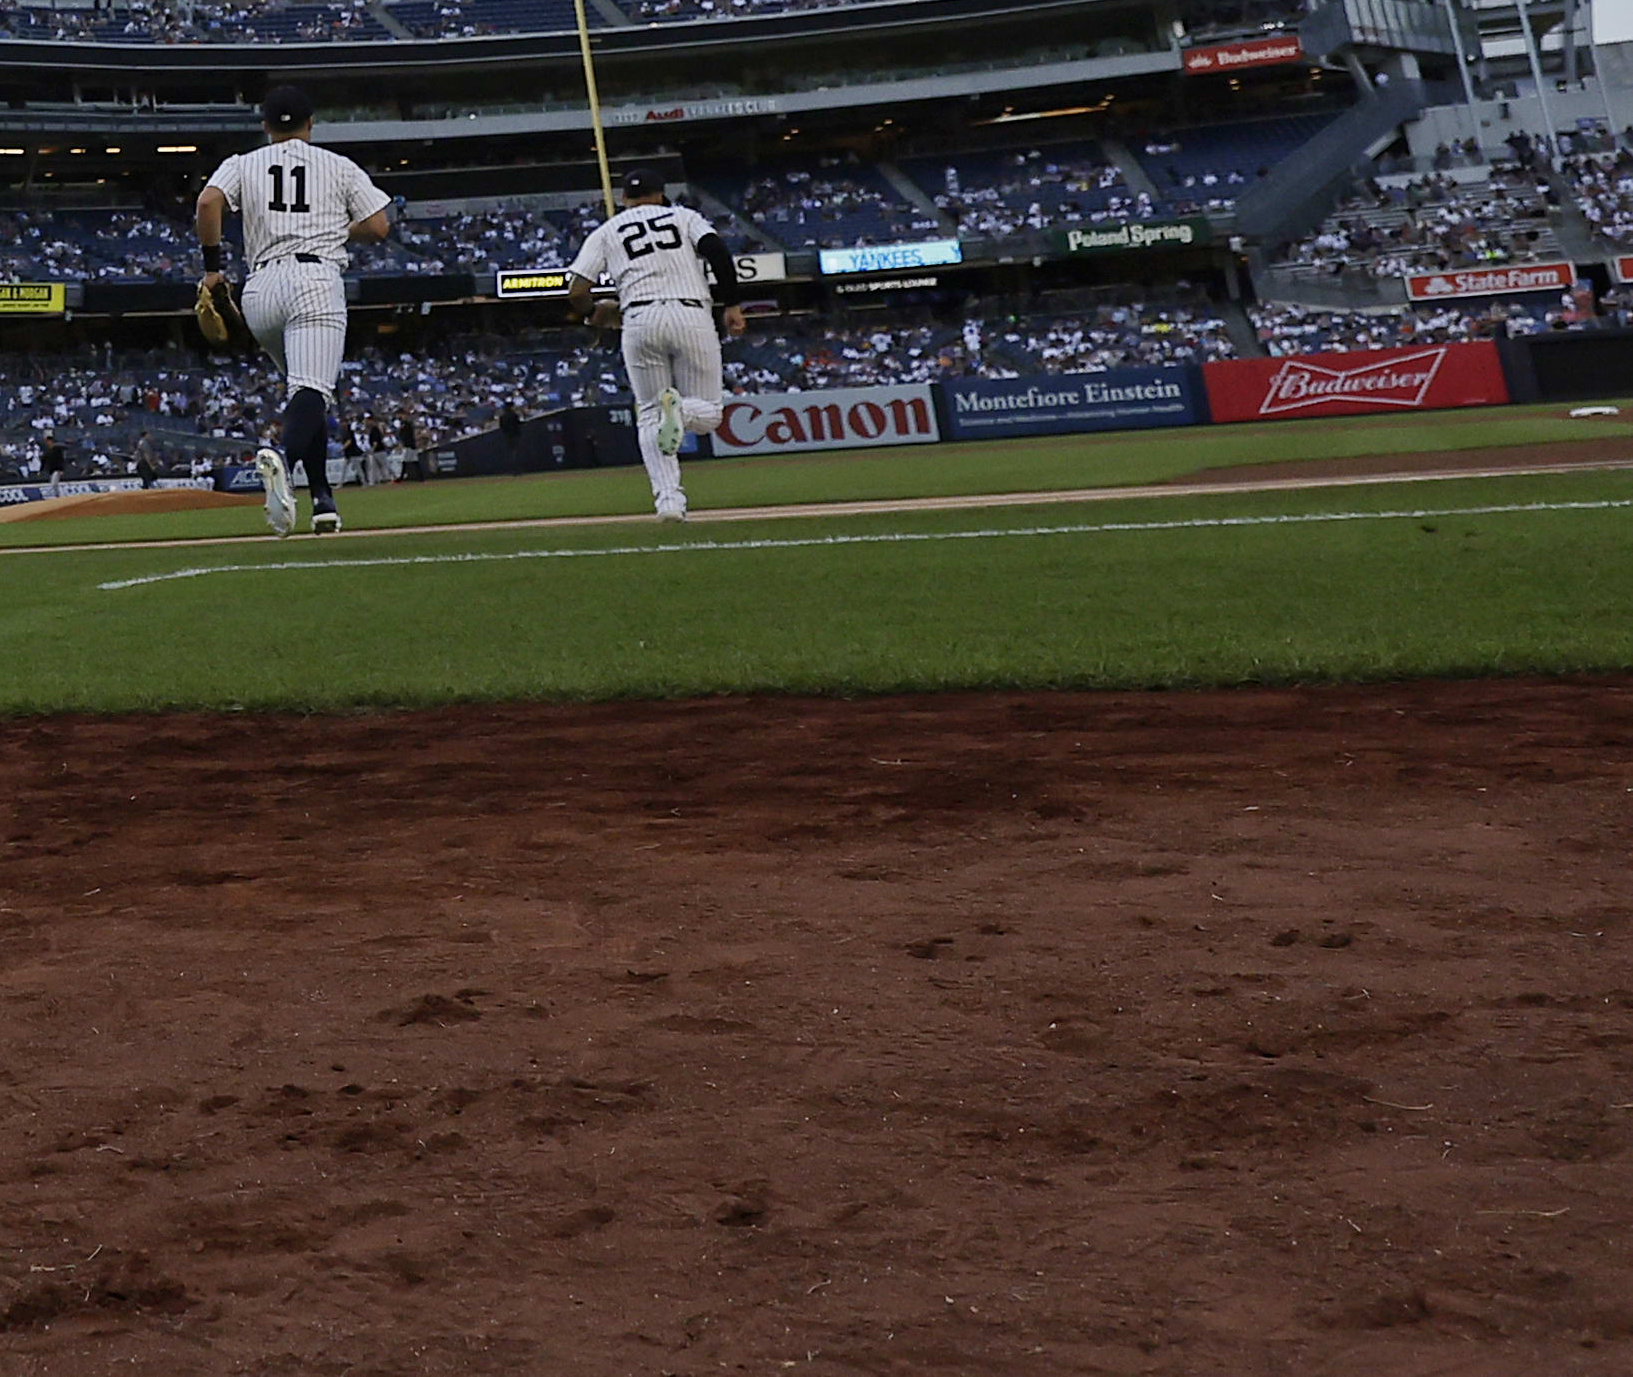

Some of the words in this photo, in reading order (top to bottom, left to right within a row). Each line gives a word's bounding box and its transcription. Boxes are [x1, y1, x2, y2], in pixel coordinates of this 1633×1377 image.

[1217, 45, 1298, 66] Budweiser
[646, 108, 685, 121] Audi
[268, 165, 310, 213] 11
[617, 212, 683, 260] 25
[1067, 224, 1129, 251] Poland
[1130, 224, 1194, 247] Spring
[849, 248, 923, 271] YANKEES
[502, 274, 564, 290] ARMITRON
[954, 387, 1080, 413] Montefiore
[1084, 379, 1182, 405] Einstein
[1270, 370, 1431, 399] Budweiser
[714, 397, 931, 447] Canon
